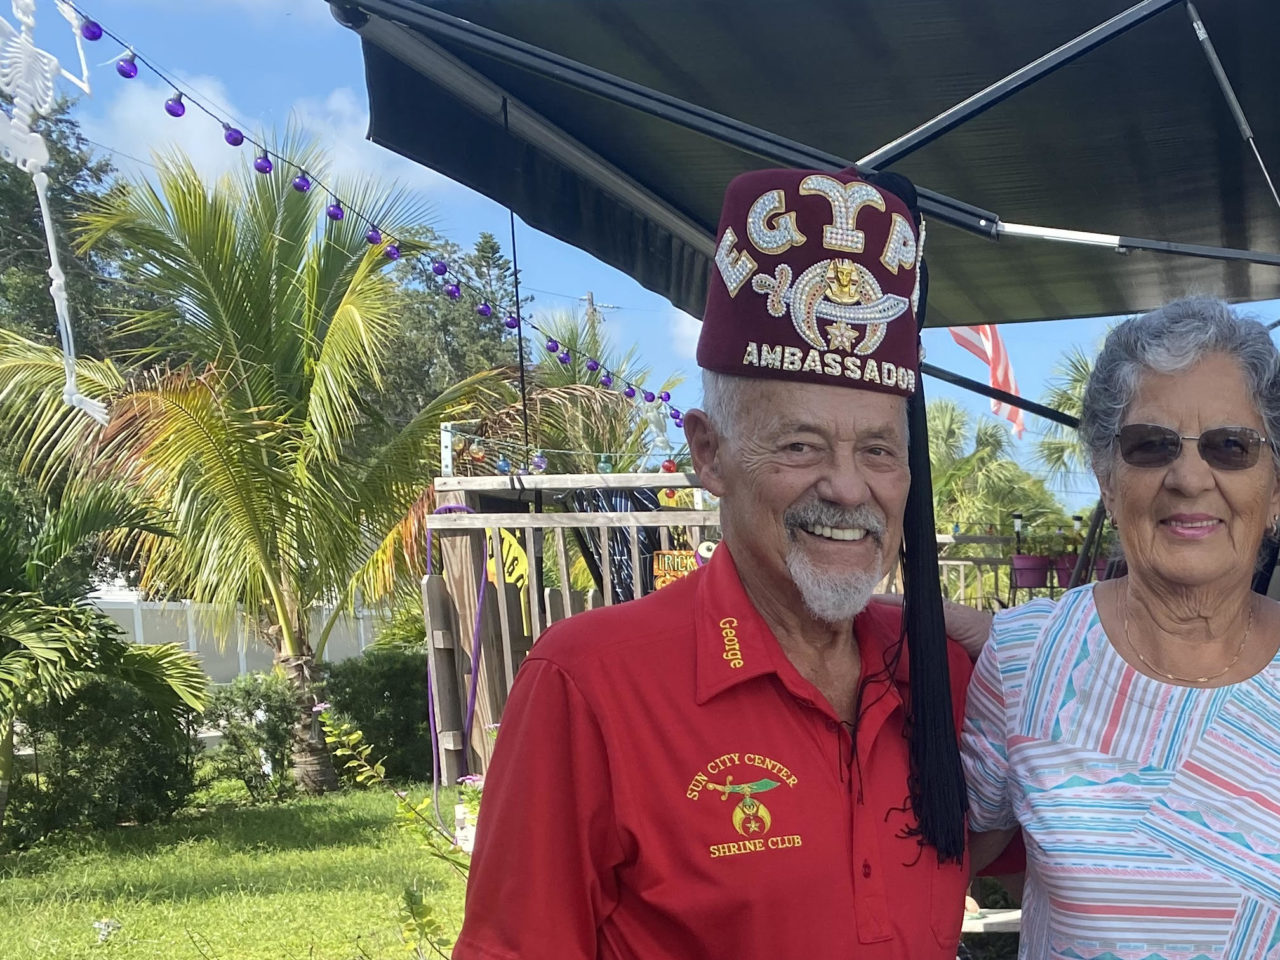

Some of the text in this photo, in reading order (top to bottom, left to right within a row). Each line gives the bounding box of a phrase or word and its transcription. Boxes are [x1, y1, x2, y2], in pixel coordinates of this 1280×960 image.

[714, 174, 919, 299] EGYP
[743, 341, 916, 393] AMBASSADOR
[719, 617, 744, 669] George
[686, 753, 799, 801] SUN CITY CENTER
[709, 835, 802, 858] SHRINE CLUB
